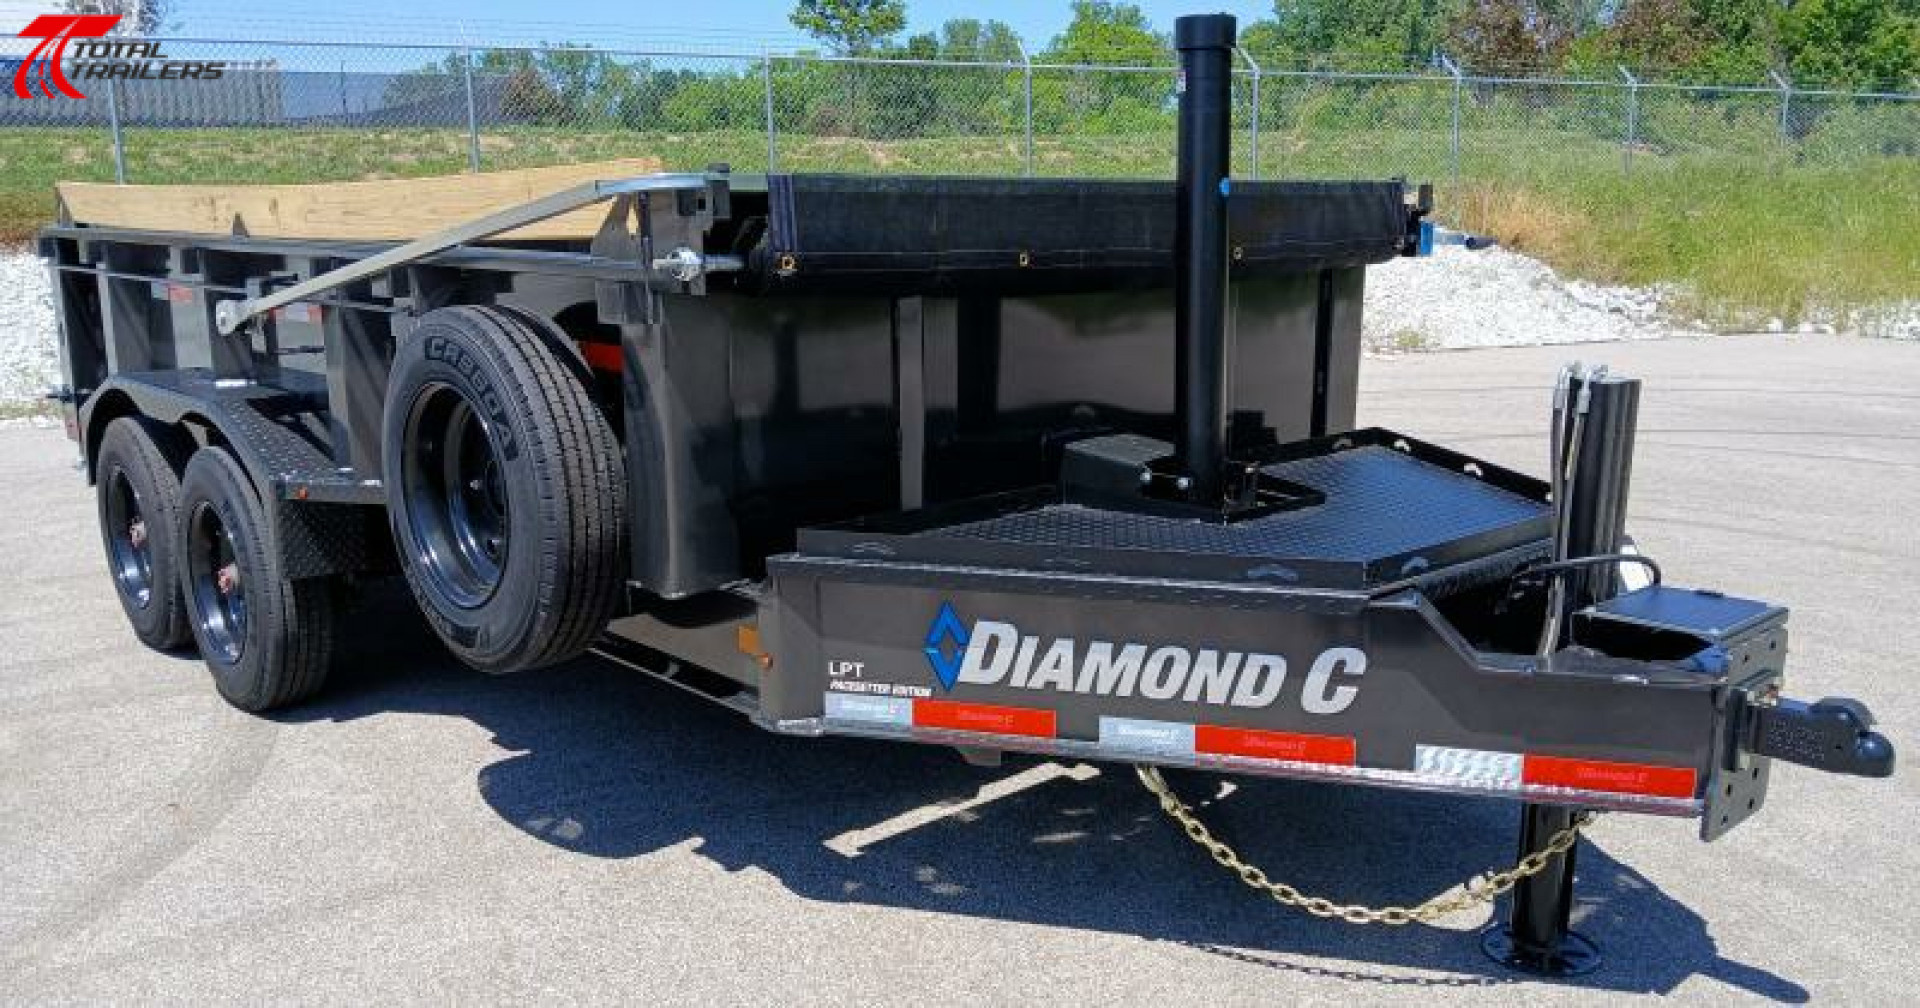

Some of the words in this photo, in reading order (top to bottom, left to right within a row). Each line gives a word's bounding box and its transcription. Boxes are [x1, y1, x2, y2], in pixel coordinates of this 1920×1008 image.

[828, 661, 864, 678] LPT
[957, 618, 1288, 708] DIAMOND
[1301, 647, 1367, 714] C
